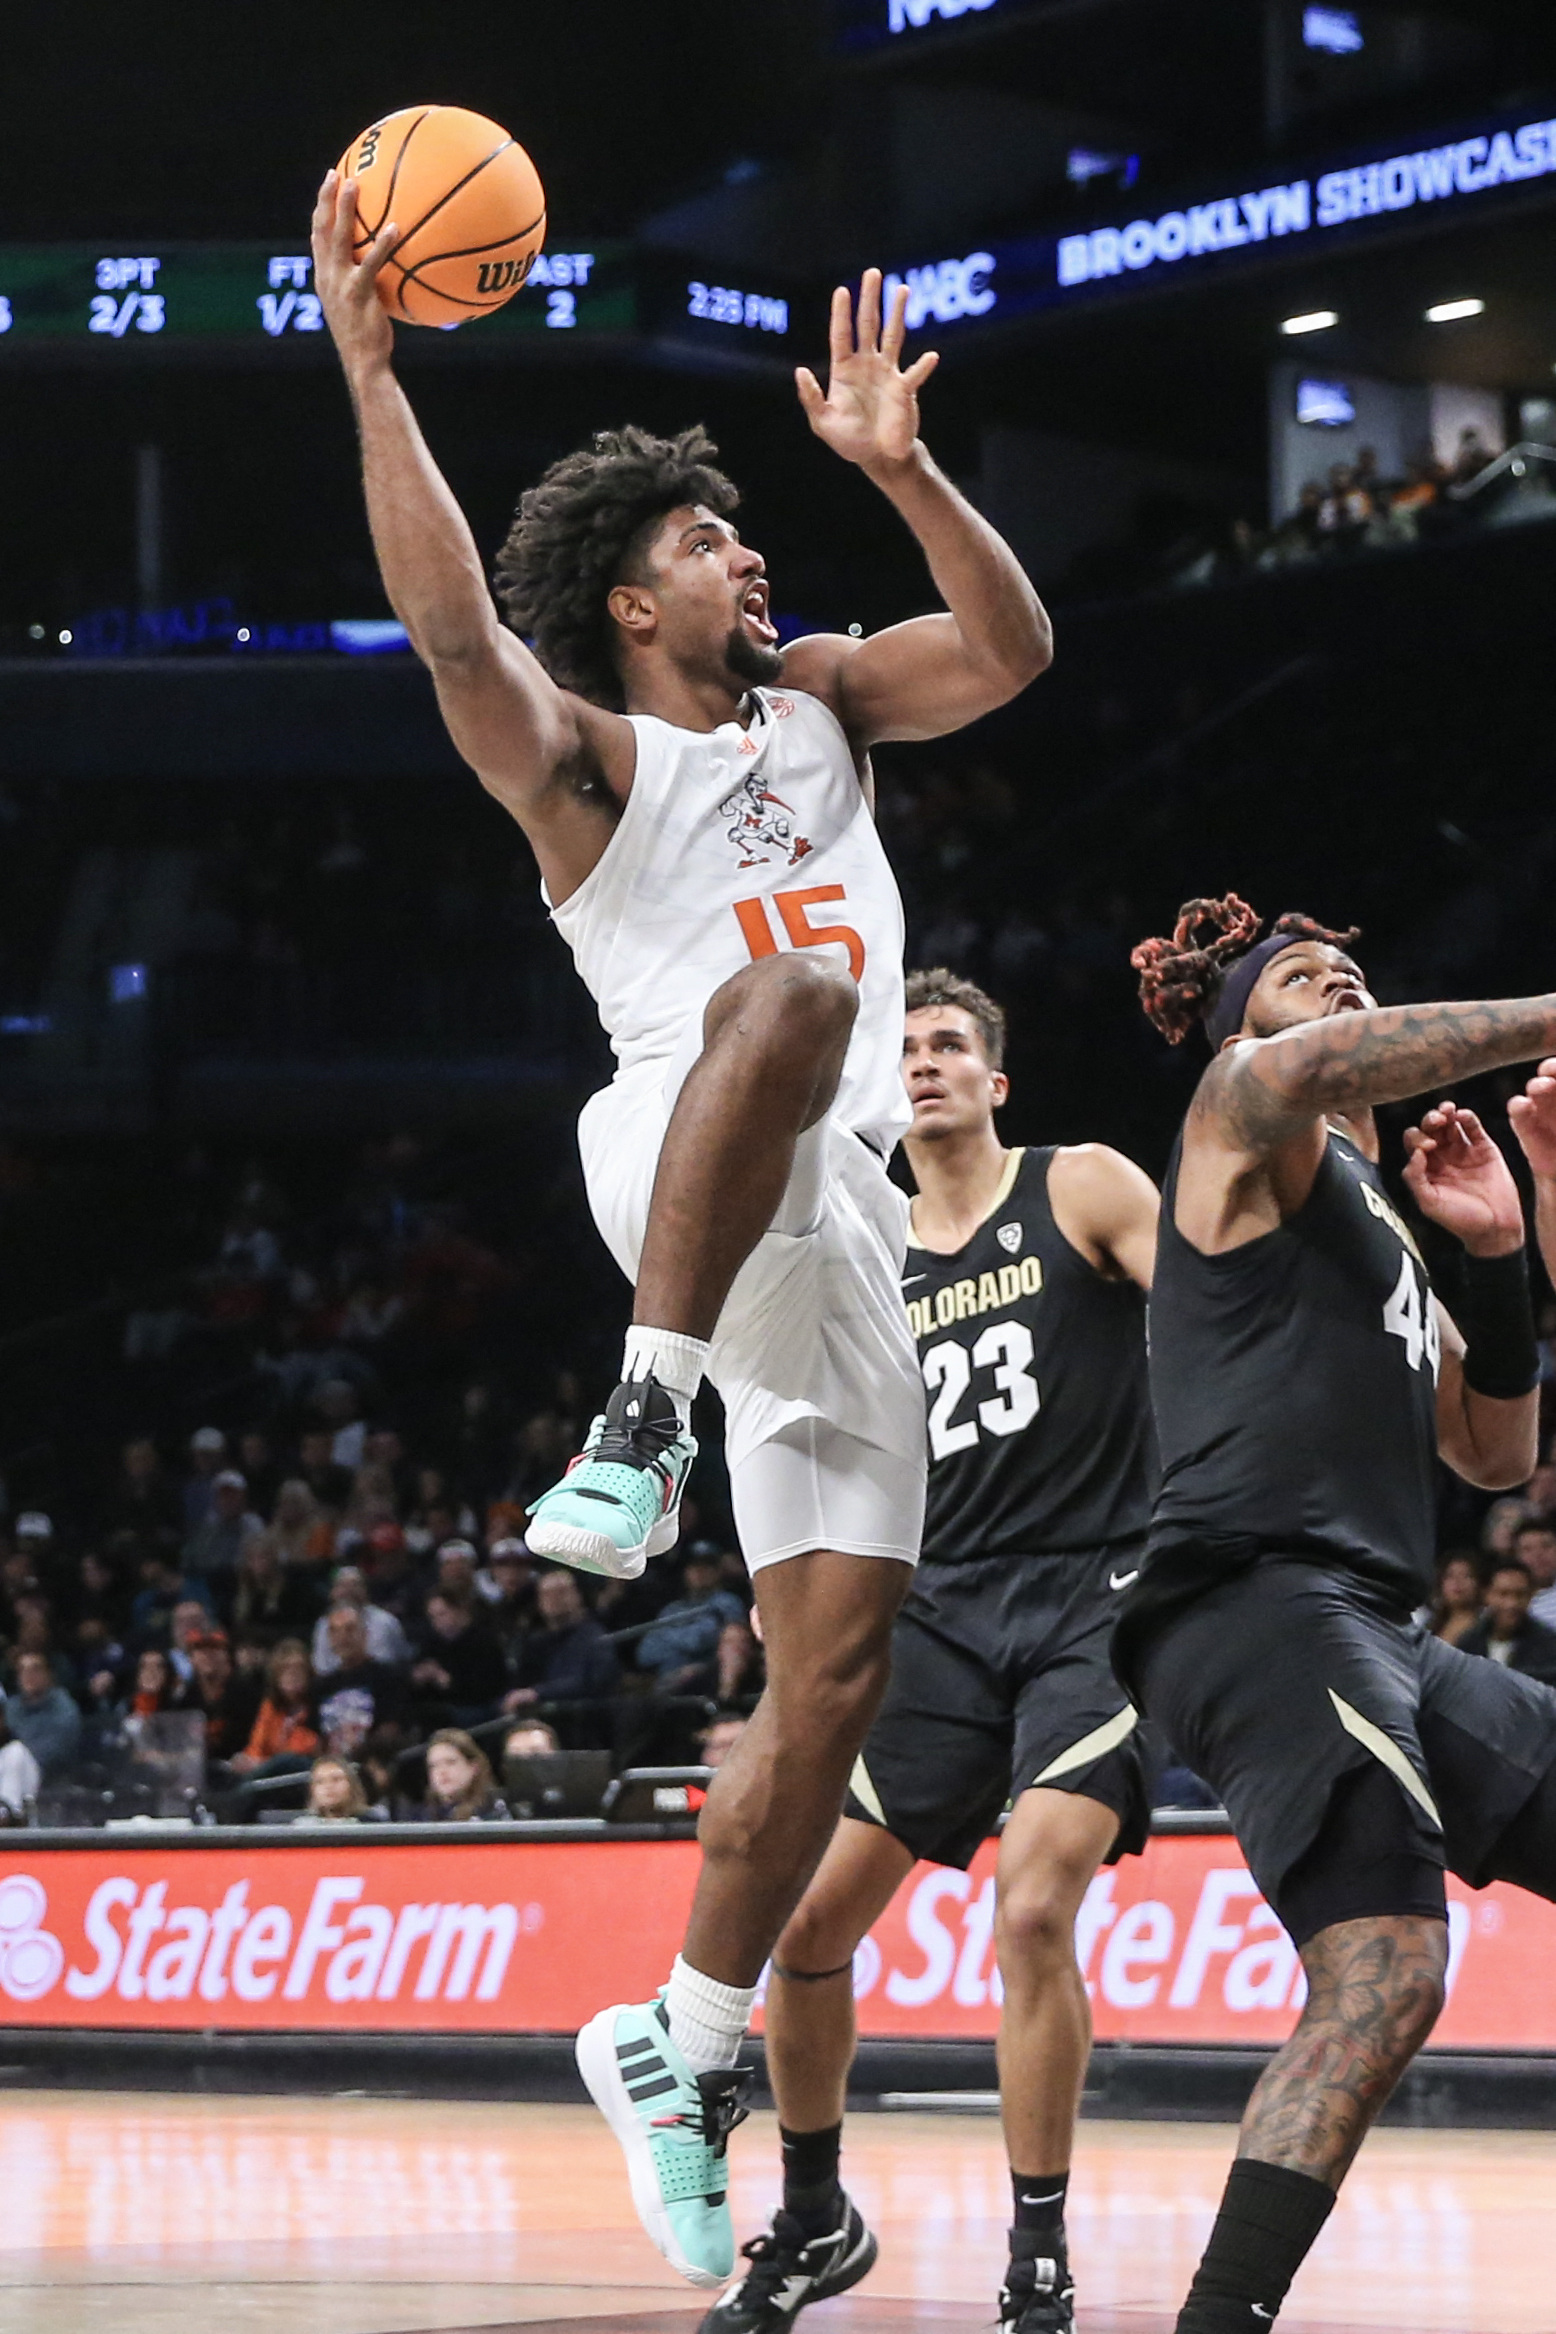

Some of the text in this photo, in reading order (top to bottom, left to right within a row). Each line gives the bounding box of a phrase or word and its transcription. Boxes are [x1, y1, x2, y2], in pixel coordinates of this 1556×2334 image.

[1057, 180, 1310, 287] BROOKLYN
[95, 257, 161, 290] 3PT
[267, 256, 312, 289] FT
[526, 253, 595, 287] AST
[88, 291, 166, 338] 2/3
[256, 290, 324, 337] 1/2
[545, 289, 577, 329] 2
[732, 884, 865, 983] 15
[905, 1255, 1043, 1340] OLORADO
[922, 1319, 1041, 1461] 23
